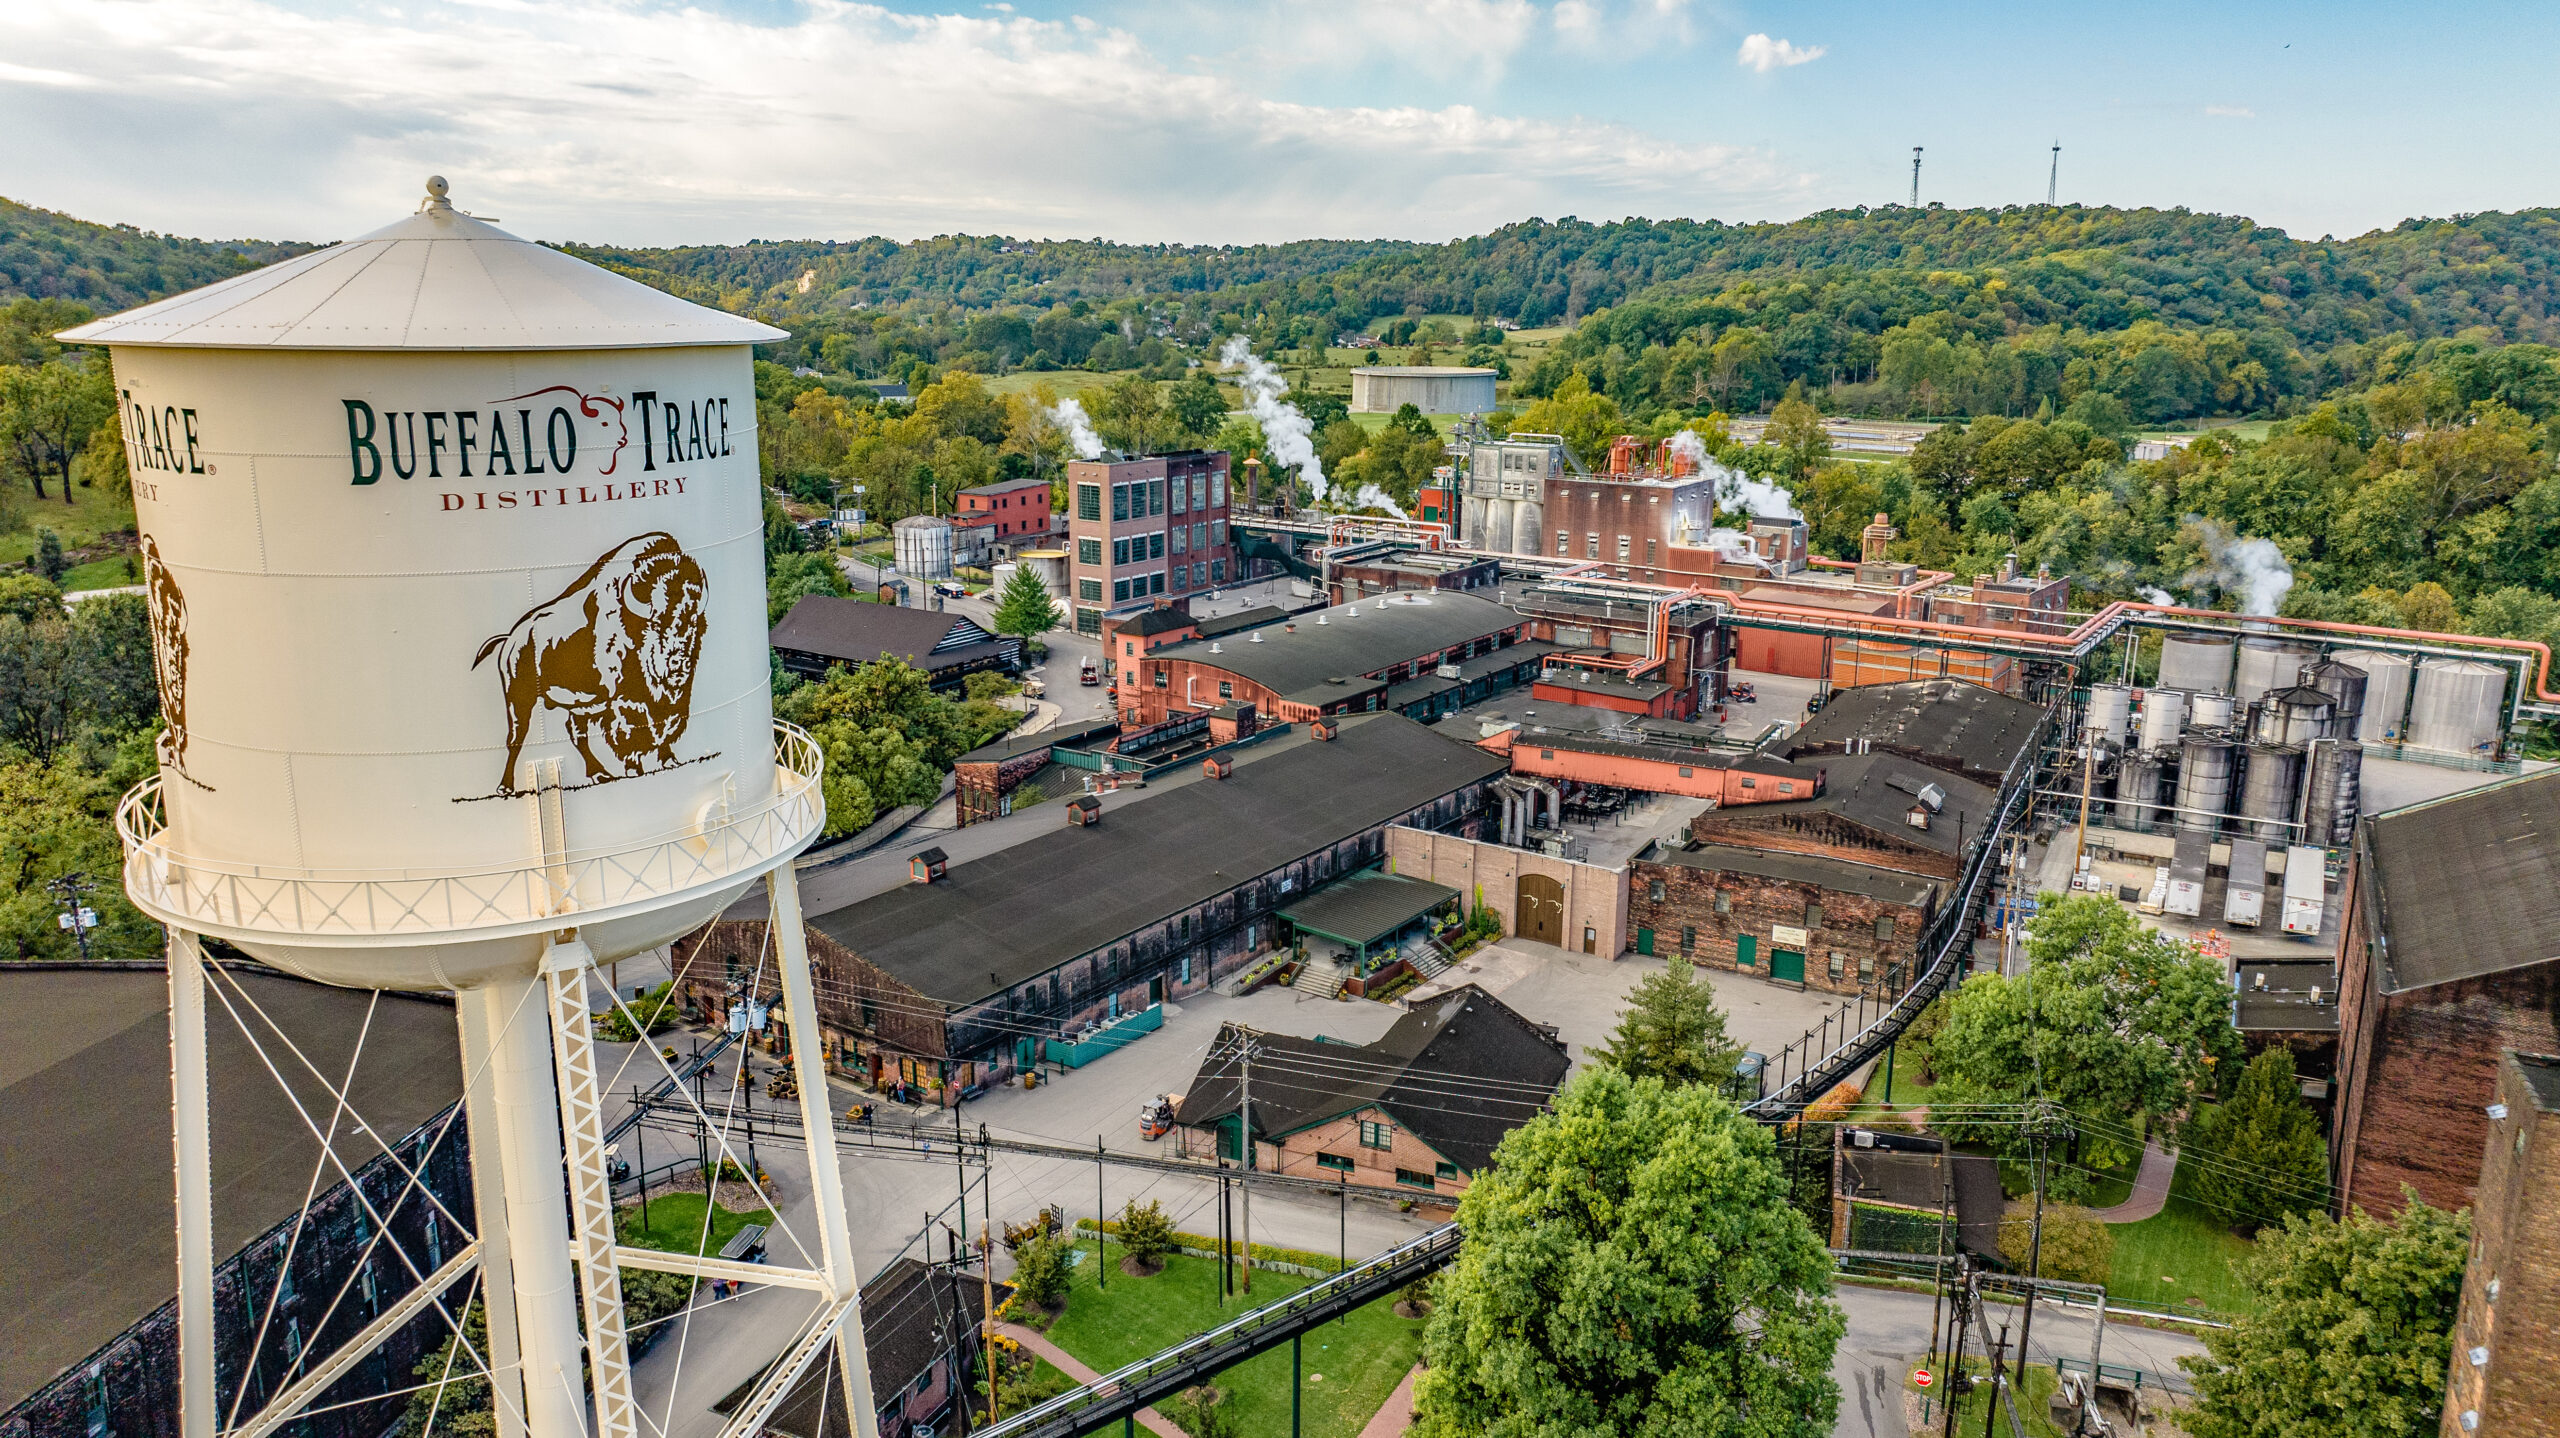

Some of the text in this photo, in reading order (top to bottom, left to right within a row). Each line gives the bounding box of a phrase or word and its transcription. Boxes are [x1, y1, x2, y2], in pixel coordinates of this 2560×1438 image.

[342, 391, 730, 486] BUFFALO TRACE
[440, 476, 688, 511] DISTILLERY
[1915, 1374, 1931, 1382] STOP
